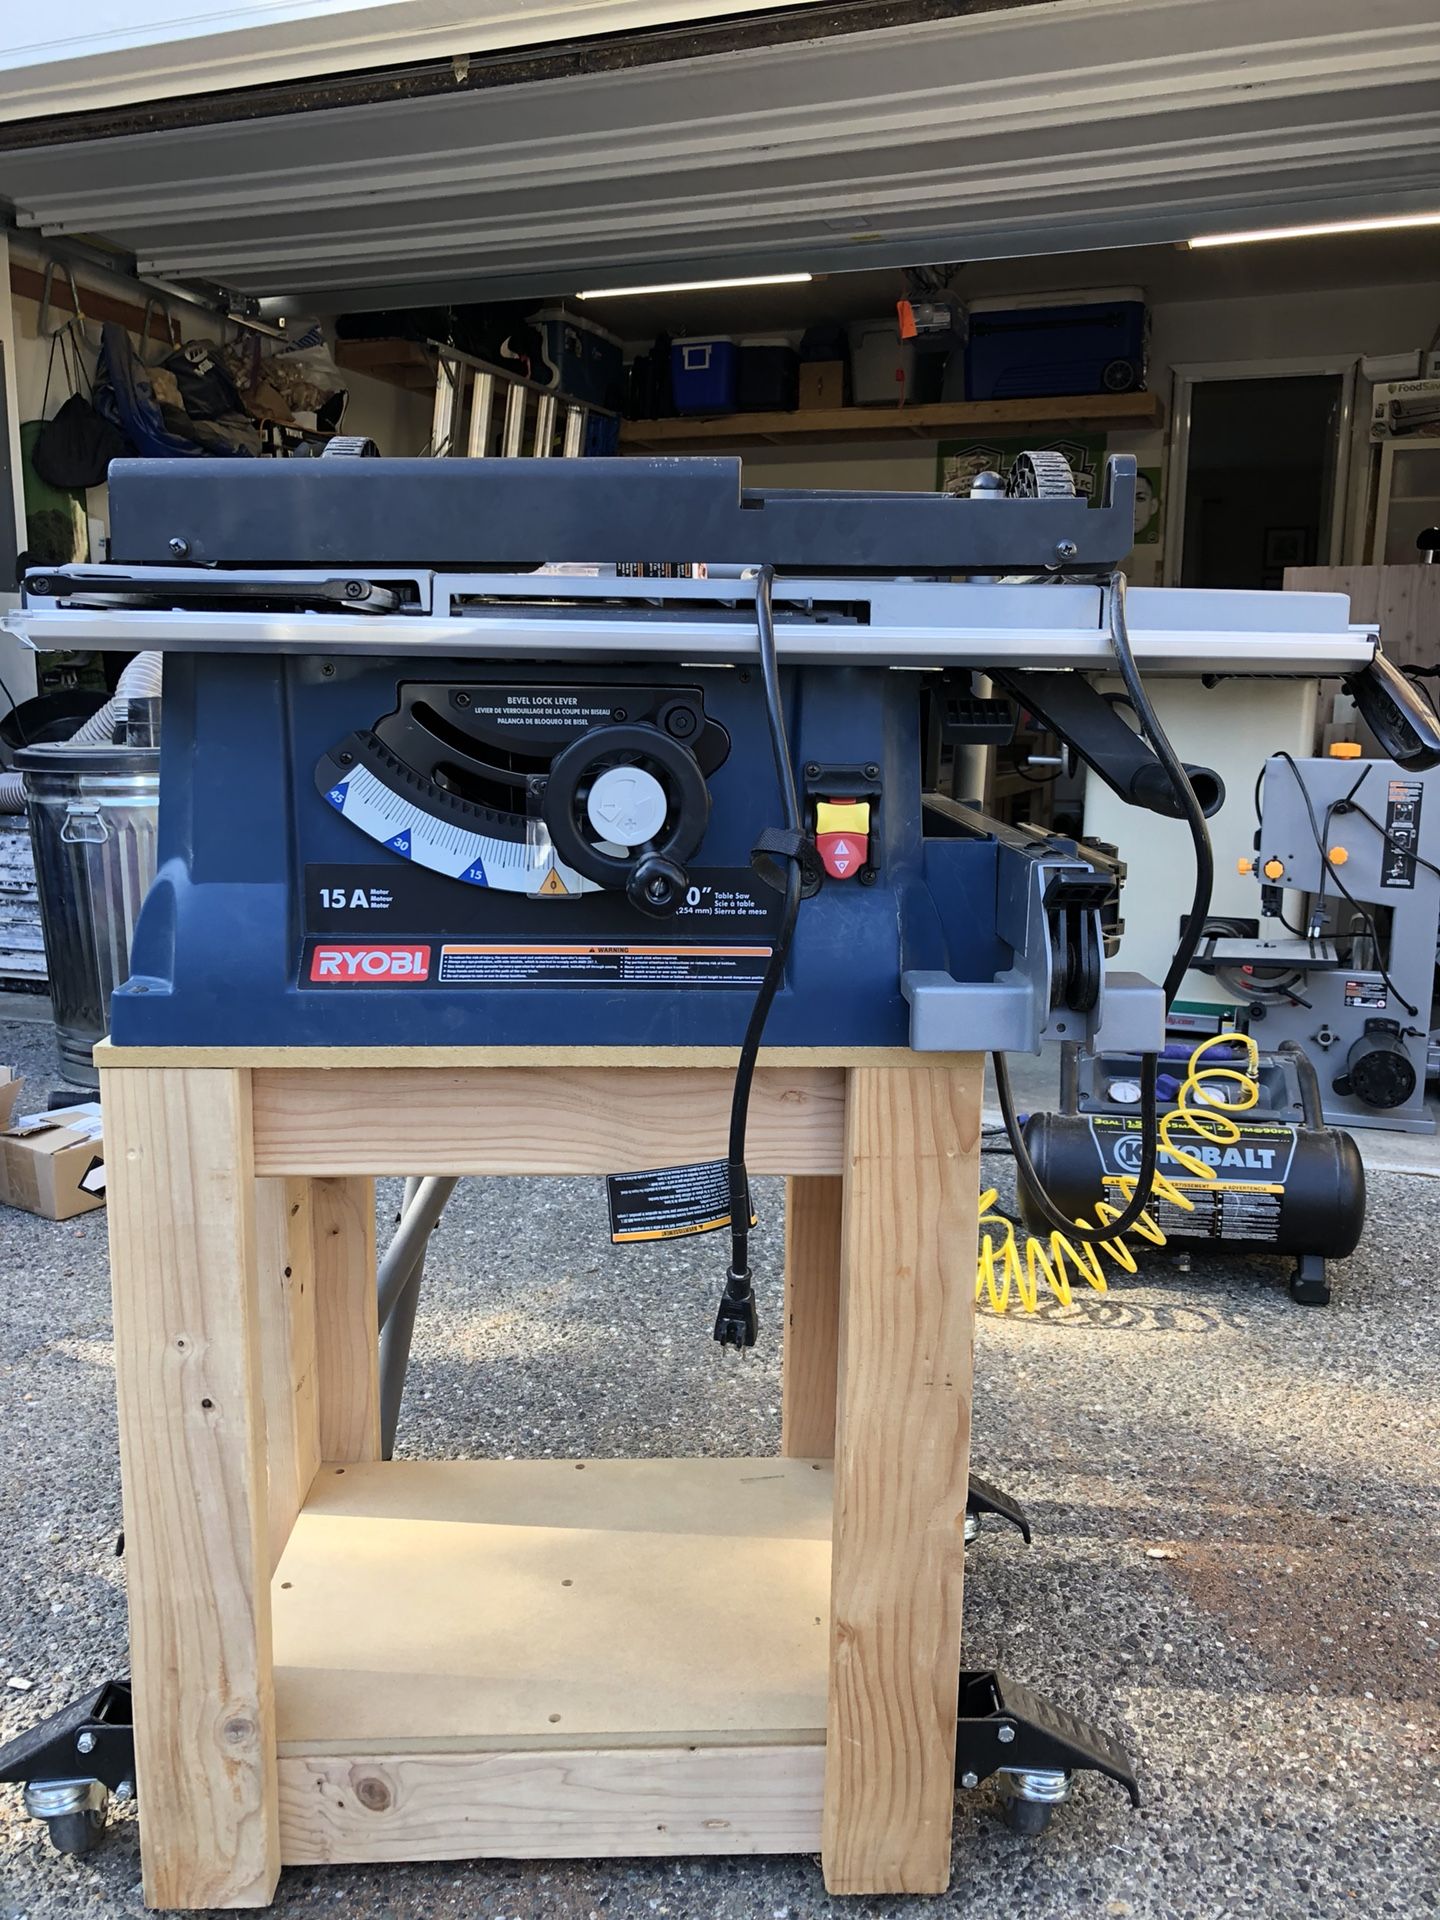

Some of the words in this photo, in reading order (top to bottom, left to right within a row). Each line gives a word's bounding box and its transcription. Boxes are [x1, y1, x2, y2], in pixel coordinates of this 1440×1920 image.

[507, 697, 530, 705] BEVEL
[533, 697, 553, 705] LOCK
[555, 697, 578, 706] LEVER
[590, 708, 611, 716] BISEAU
[497, 717, 525, 725] PALANCA
[330, 789, 344, 804] 45
[393, 837, 409, 851] 30
[469, 869, 482, 880] 15
[550, 880, 557, 890] 0
[319, 888, 346, 909] 15
[349, 888, 369, 909] A
[686, 886, 712, 906] 0"
[695, 907, 713, 916] mm)
[319, 951, 423, 975] RYOBI
[1159, 1145, 1276, 1169] KOBALT
